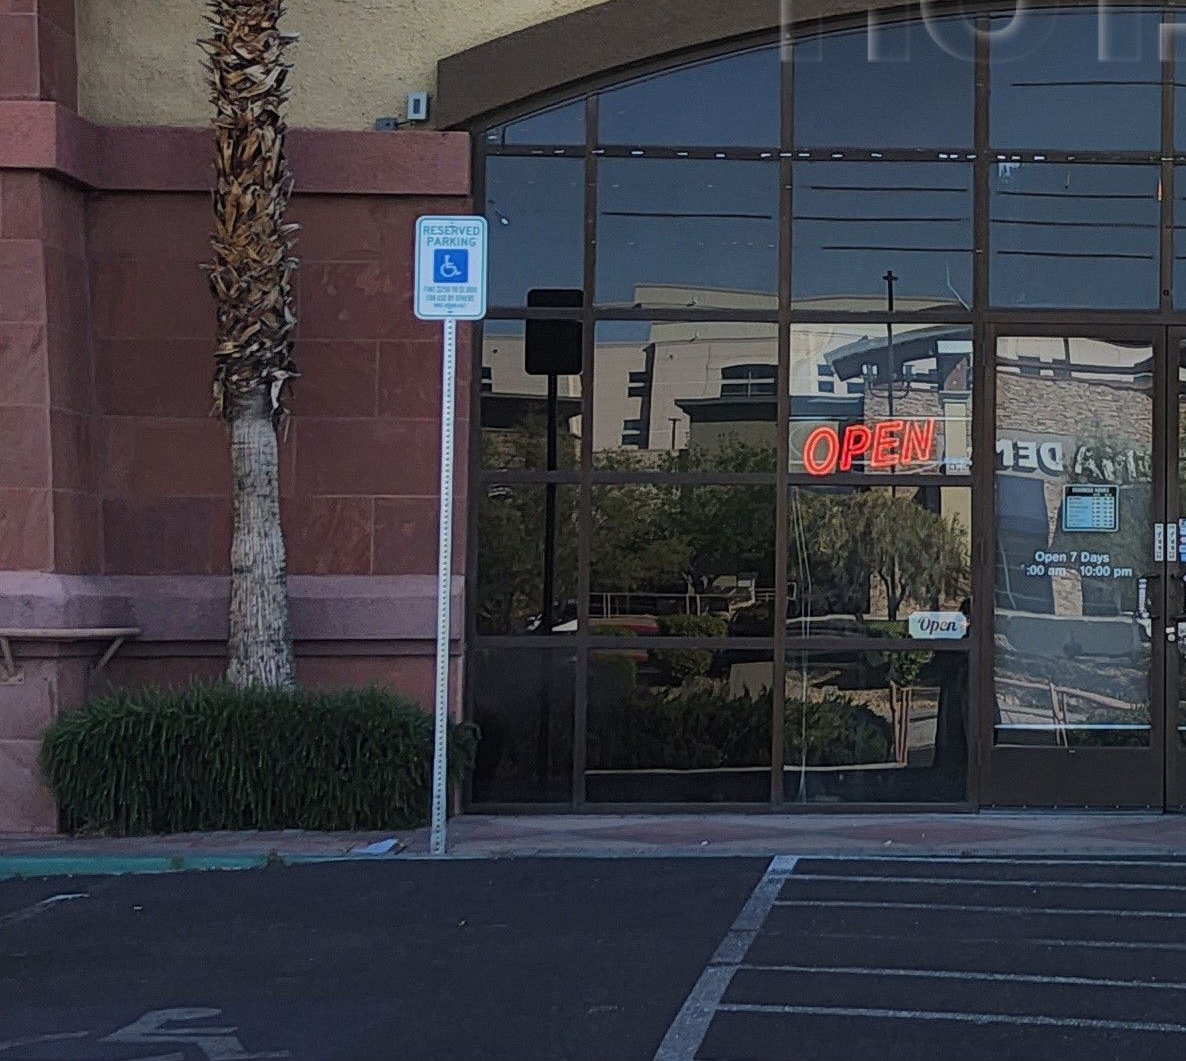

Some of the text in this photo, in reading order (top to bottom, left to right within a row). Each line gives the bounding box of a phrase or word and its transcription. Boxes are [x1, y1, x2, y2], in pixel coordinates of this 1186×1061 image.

[423, 225, 480, 236] RESERVED
[427, 237, 476, 247] PARKING
[803, 418, 936, 476] OPEN
[1035, 551, 1110, 564] Open 7 Days
[1048, 566, 1066, 576] am
[1080, 565, 1111, 577] 10:00
[1114, 567, 1133, 579] pm
[917, 616, 958, 636] Open
